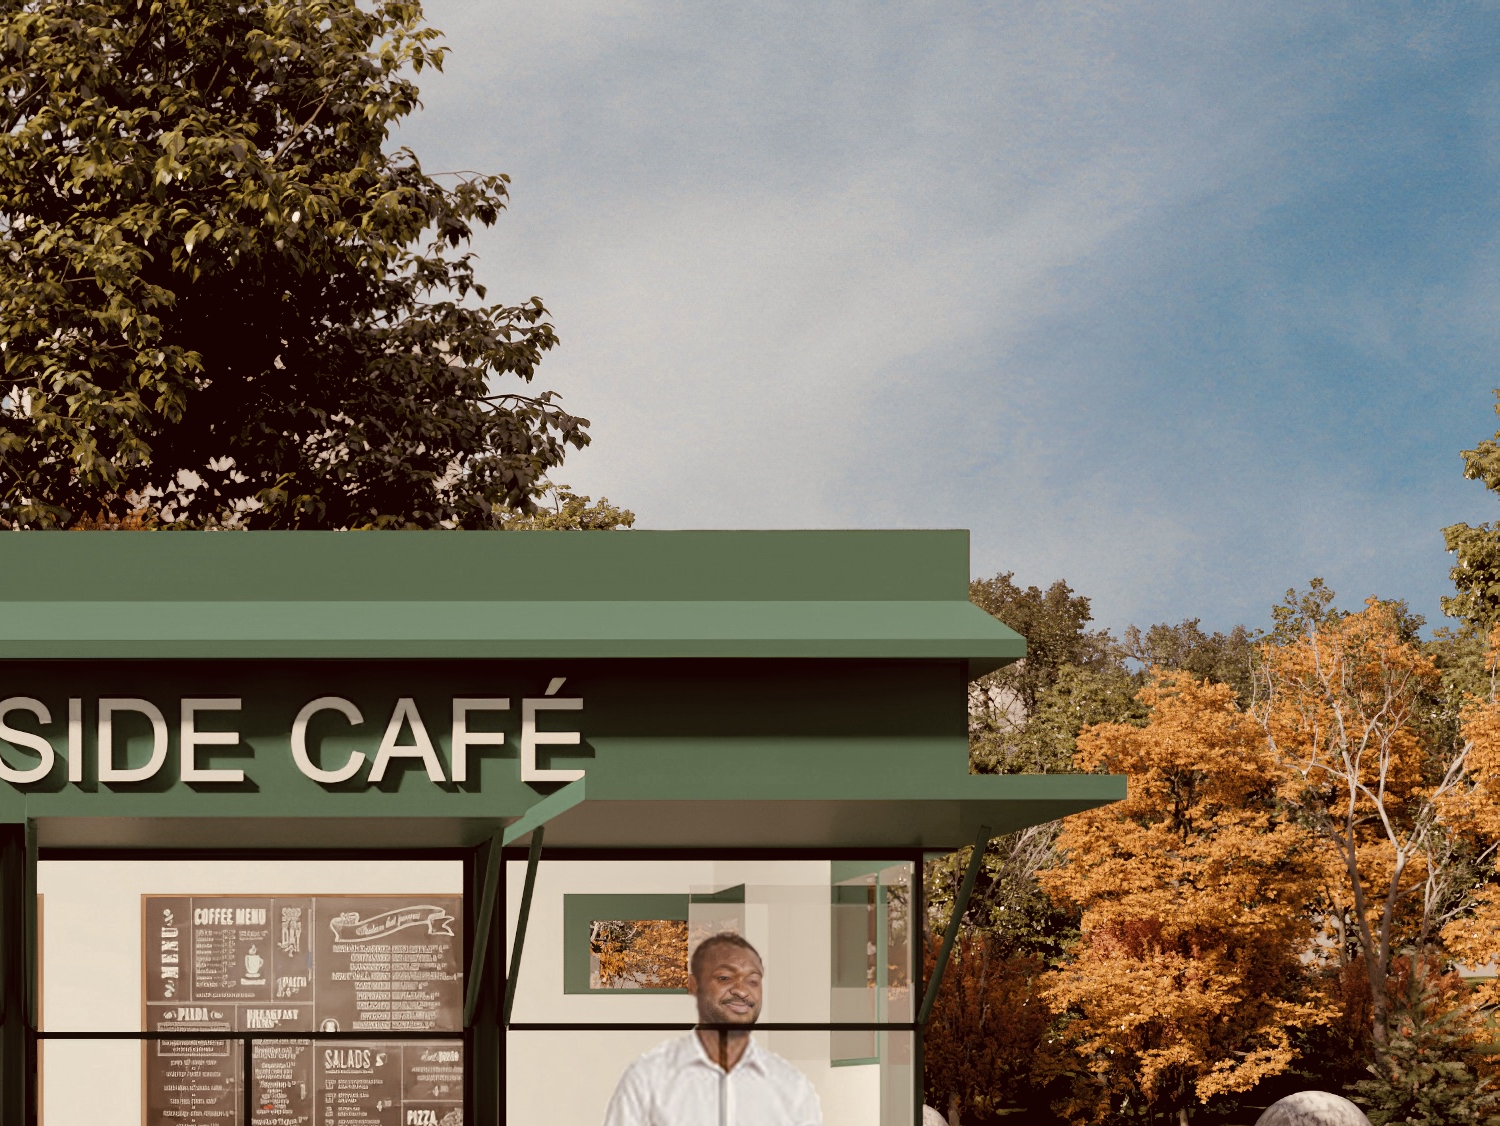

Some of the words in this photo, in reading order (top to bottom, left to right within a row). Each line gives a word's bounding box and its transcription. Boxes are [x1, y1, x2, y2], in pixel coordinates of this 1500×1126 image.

[289, 677, 586, 785] CAFÉ
[194, 908, 234, 925] COFFEE
[235, 908, 267, 925] MENU
[161, 926, 179, 979] MENU
[324, 1049, 371, 1069] SALADS
[406, 1110, 438, 1126] PIZZA
